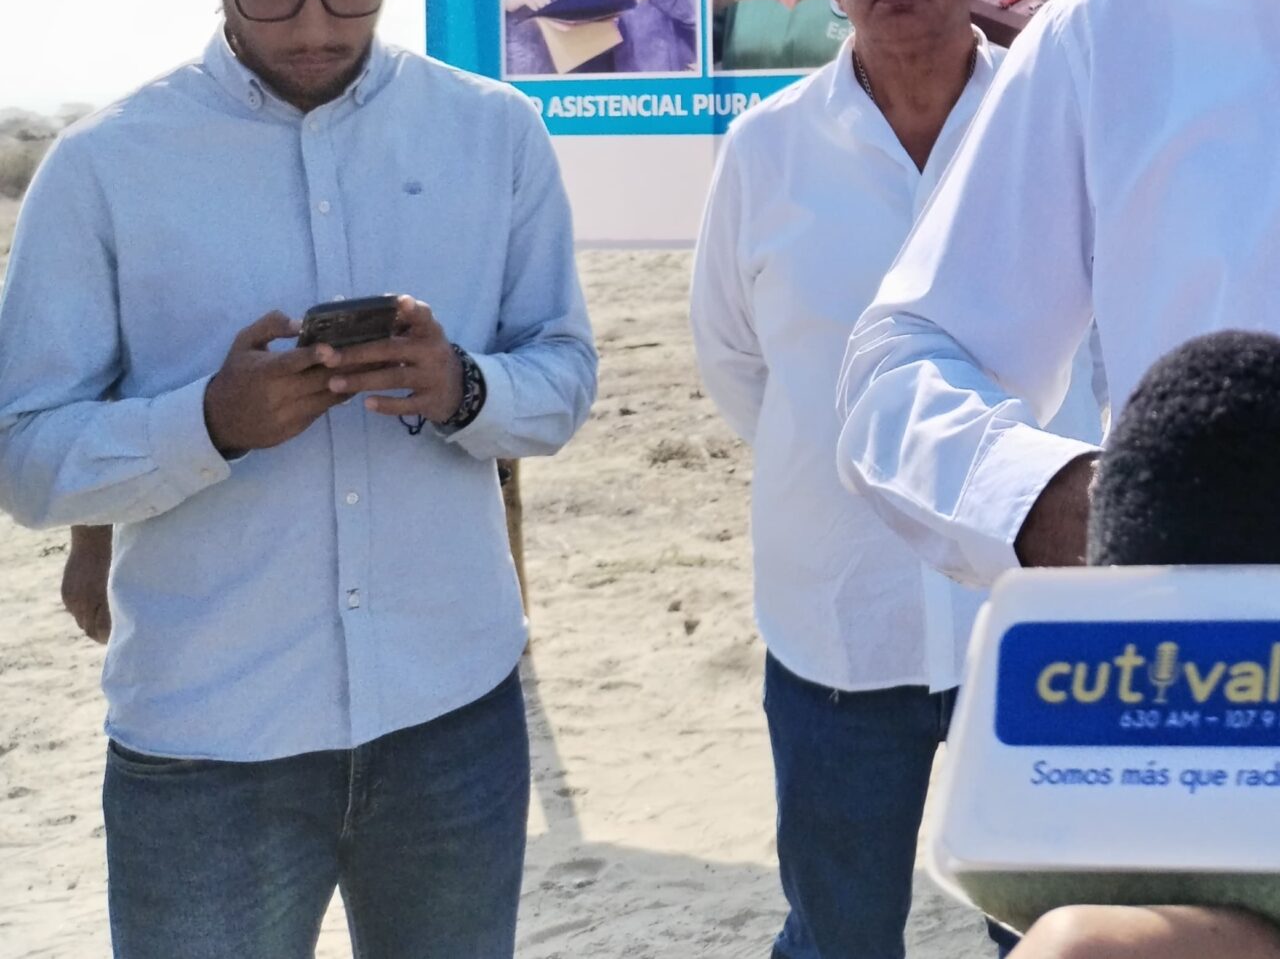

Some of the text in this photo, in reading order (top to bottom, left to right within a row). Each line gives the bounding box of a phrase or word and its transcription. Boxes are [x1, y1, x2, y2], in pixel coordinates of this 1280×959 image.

[547, 93, 689, 119] ASISTENCIAL
[1118, 709, 1161, 728] 630
[1164, 709, 1200, 728] AM
[1029, 759, 1114, 786] Somos
[1120, 759, 1171, 786] más
[1178, 768, 1229, 794] que
